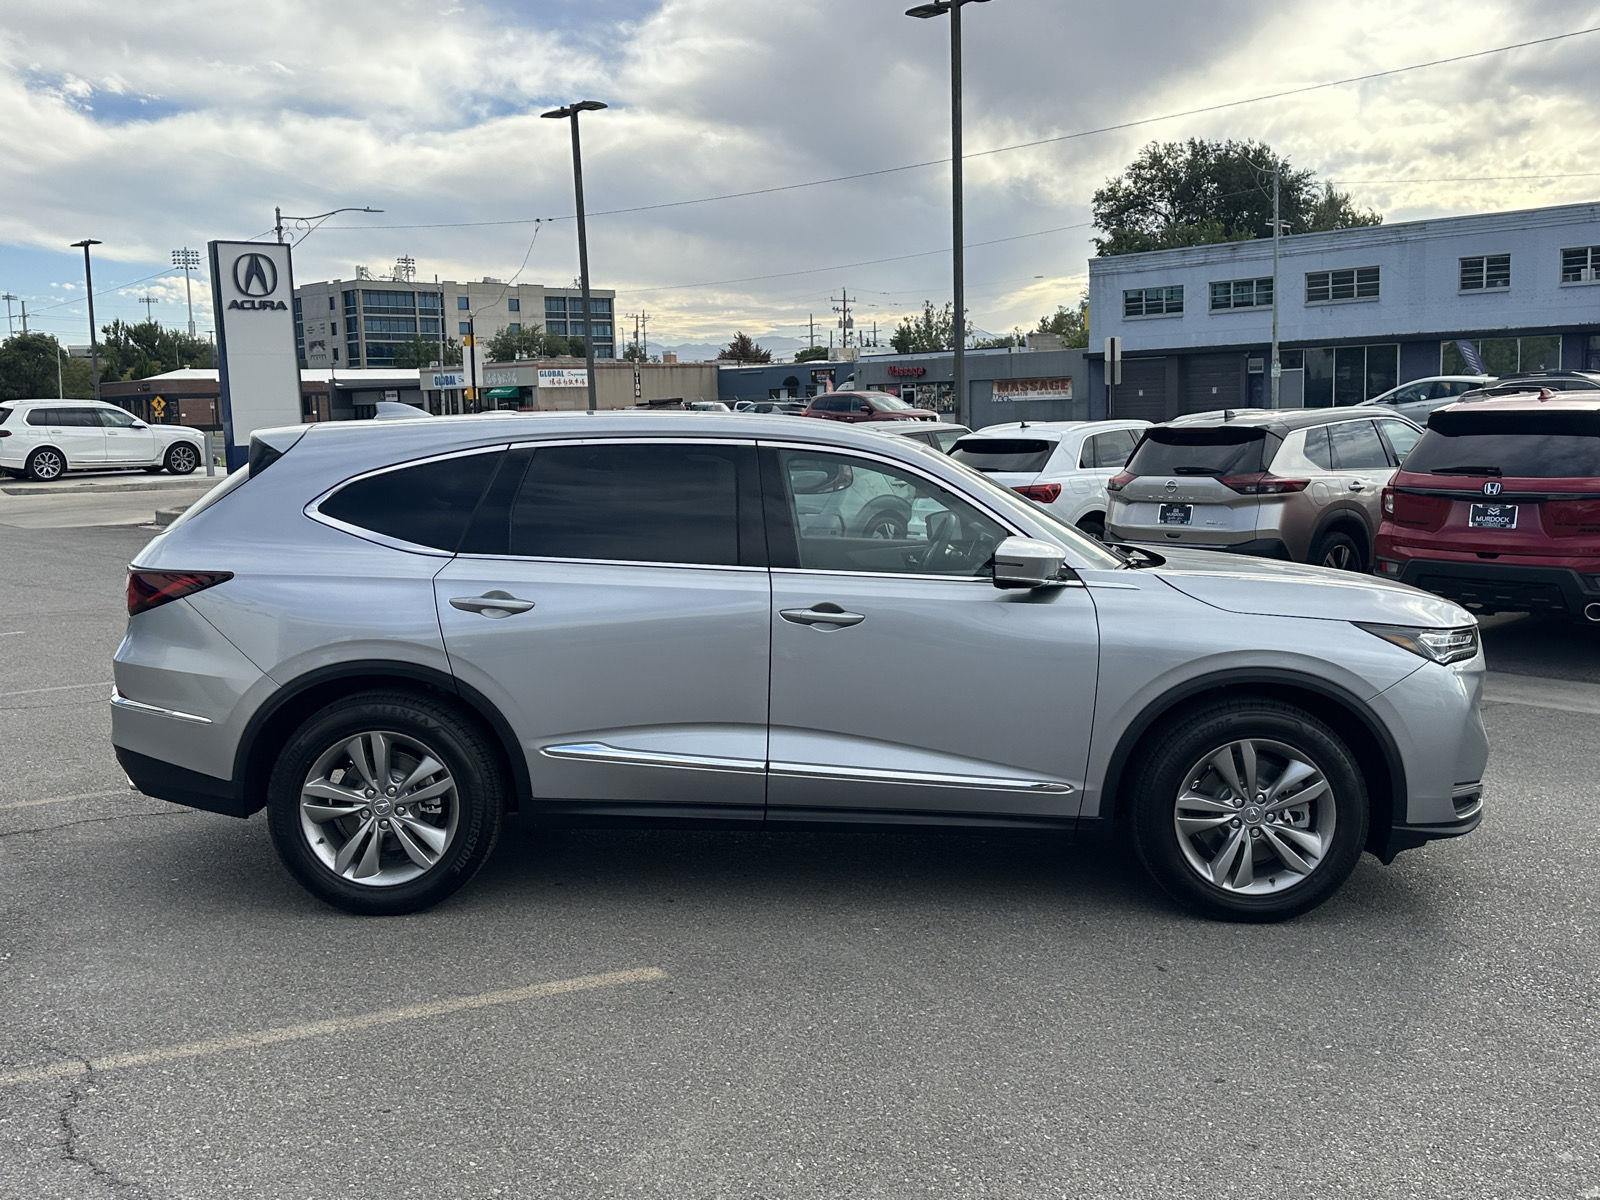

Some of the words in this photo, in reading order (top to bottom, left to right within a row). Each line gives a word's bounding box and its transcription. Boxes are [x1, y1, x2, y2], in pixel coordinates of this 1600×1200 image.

[228, 299, 288, 310] ACURA
[539, 370, 565, 378] GLOBAL
[887, 366, 924, 378] Massage
[997, 380, 1069, 393] MASSAGE
[1475, 515, 1510, 523] MURDOCK
